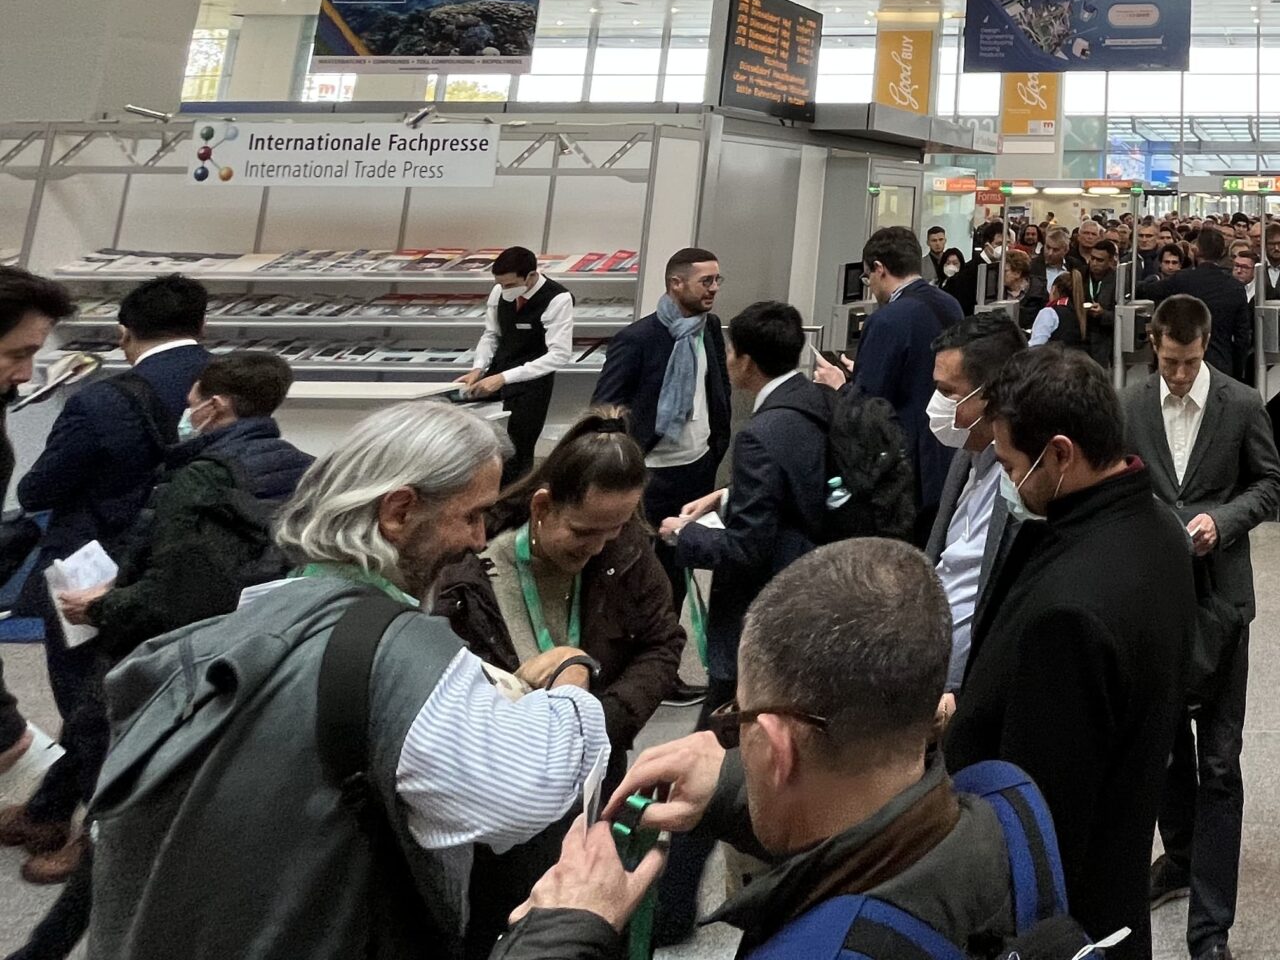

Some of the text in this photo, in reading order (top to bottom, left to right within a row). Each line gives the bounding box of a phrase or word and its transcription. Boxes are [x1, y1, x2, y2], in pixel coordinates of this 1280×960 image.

[889, 36, 919, 109] Good BUY
[248, 133, 489, 155] Internationale Fachpresse
[244, 160, 444, 178] International Trade Press
[977, 191, 1002, 201] Forms
